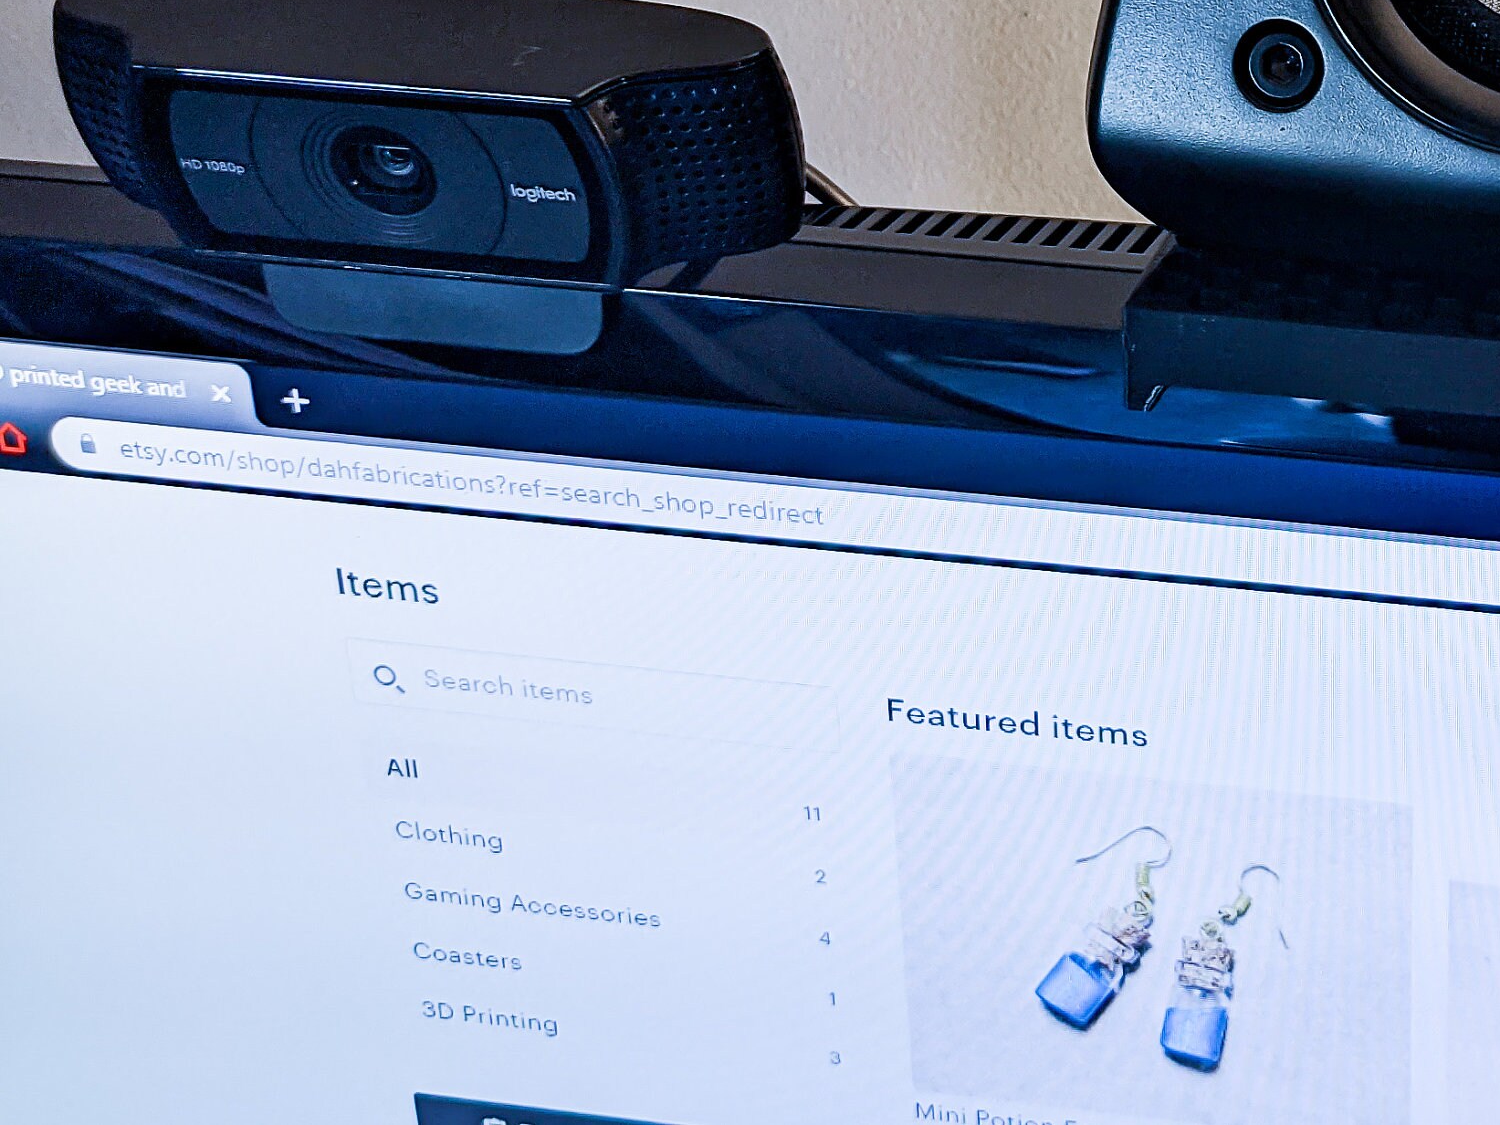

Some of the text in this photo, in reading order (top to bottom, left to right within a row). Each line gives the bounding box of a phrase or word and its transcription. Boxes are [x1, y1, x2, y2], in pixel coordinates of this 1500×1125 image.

[180, 158, 246, 175] HD 1080p
[510, 183, 577, 203] logitech
[10, 365, 85, 388] printed
[90, 375, 143, 396] geek
[147, 380, 187, 398] and
[120, 441, 824, 527] etsy.com/shop/dahfabrications?ref=search_shop_redirect
[336, 568, 440, 604] Items
[424, 670, 593, 704] Search items
[886, 698, 1149, 748] Featured items
[387, 758, 418, 779] All
[803, 806, 821, 822] 11
[395, 821, 503, 853] Clothing
[815, 870, 827, 884] 2
[404, 882, 661, 928] Gaming Accessories
[819, 932, 831, 946] 4
[413, 942, 522, 971] Coasters
[829, 992, 835, 1007] 1
[421, 1000, 559, 1037] 3D Printing
[829, 1051, 841, 1064] 3
[915, 1102, 966, 1124] Mini
